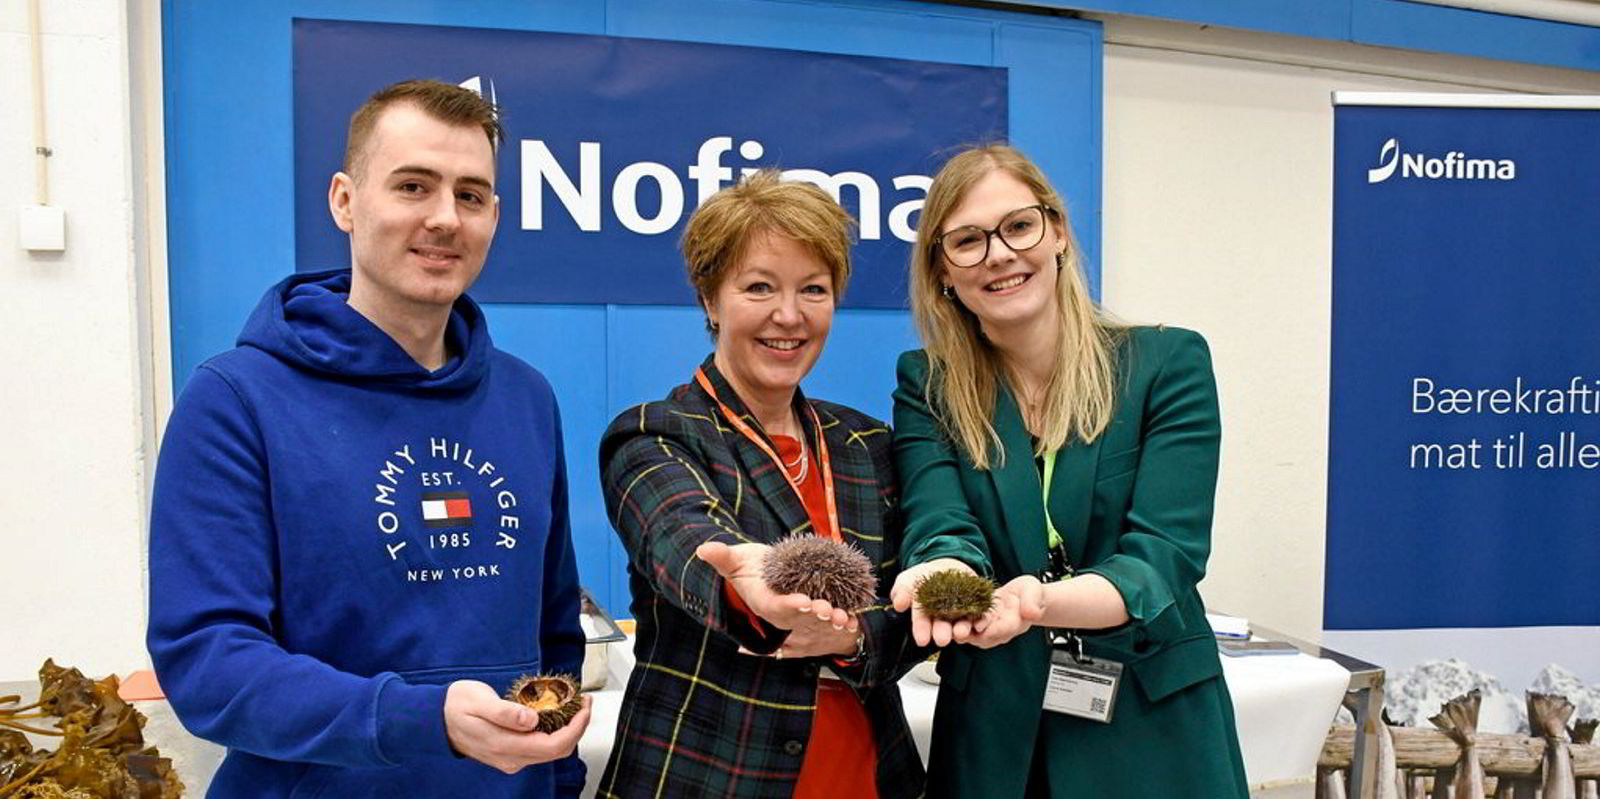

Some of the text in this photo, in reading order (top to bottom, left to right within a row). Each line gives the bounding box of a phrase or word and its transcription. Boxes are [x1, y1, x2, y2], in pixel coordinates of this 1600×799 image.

[1402, 151, 1515, 180] Nofima
[1411, 376, 1600, 414] Bærekrafti
[1409, 431, 1600, 469] mat til alle
[421, 472, 462, 486] EST.
[375, 437, 519, 561] TOMMY HILFIGER
[429, 532, 471, 549] 1985
[408, 564, 500, 582] NEW YORK
